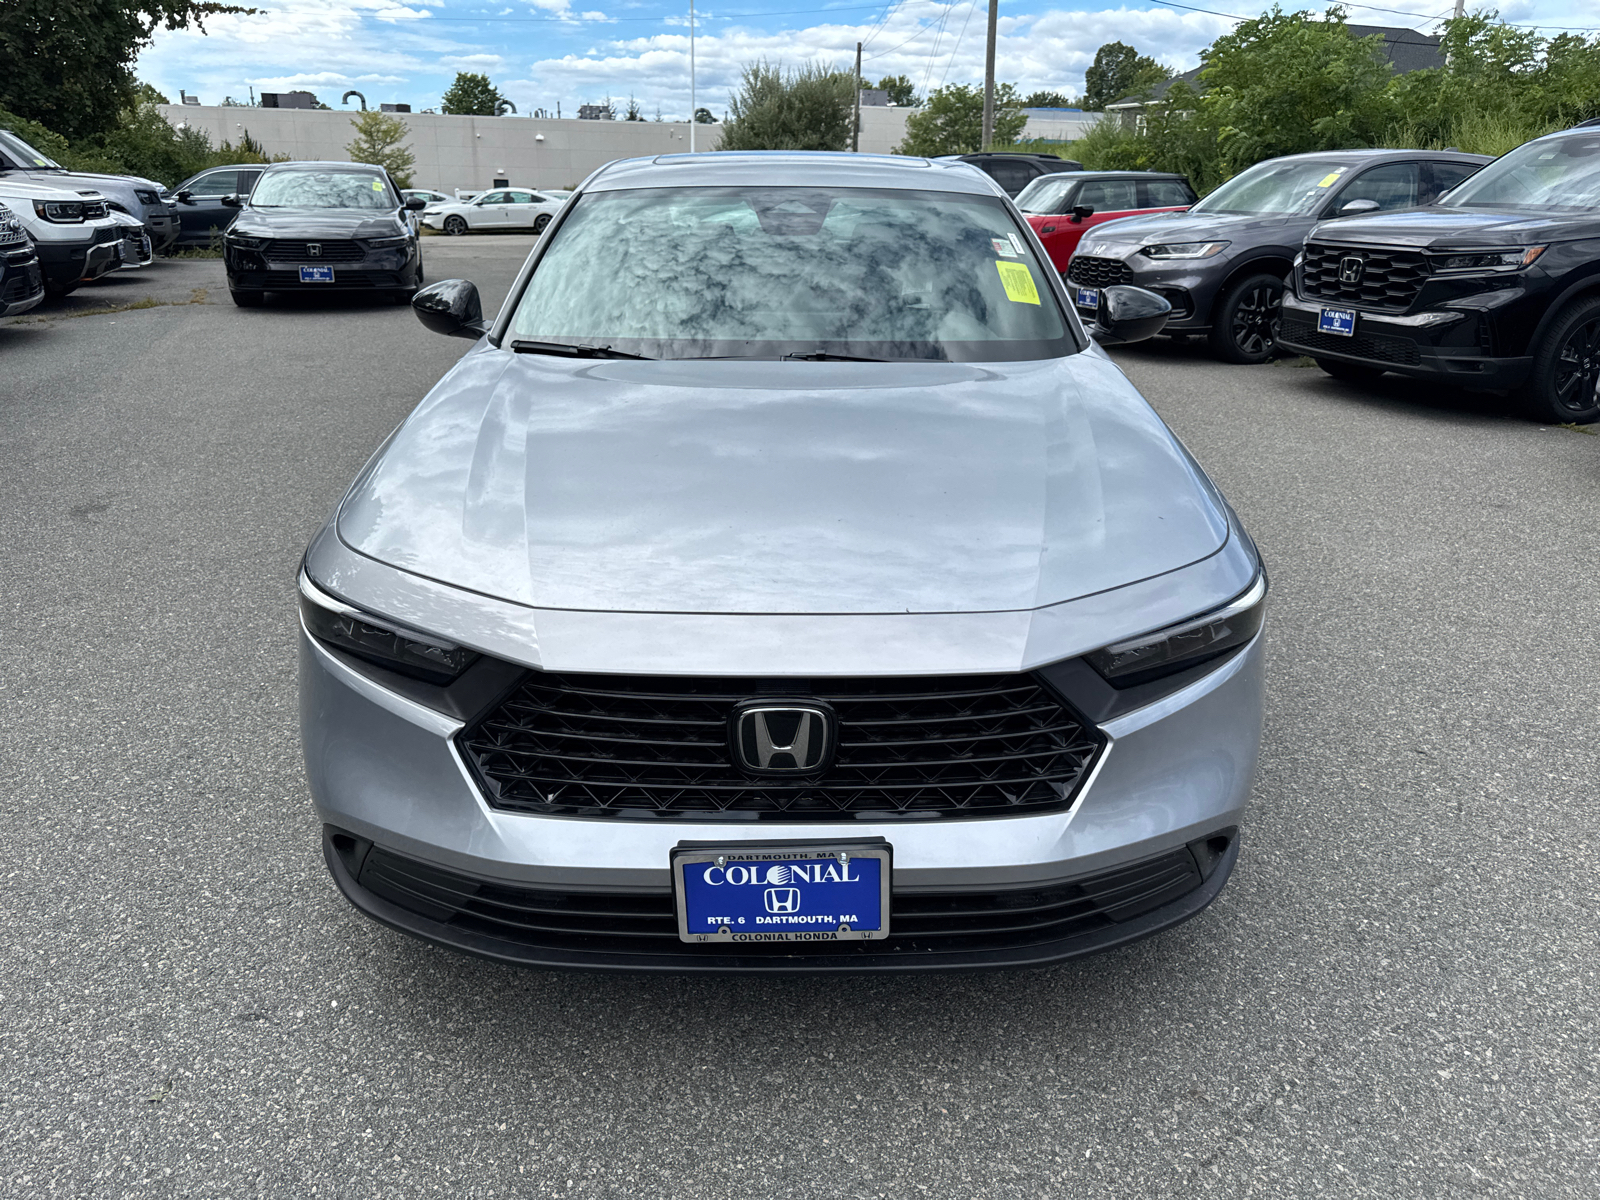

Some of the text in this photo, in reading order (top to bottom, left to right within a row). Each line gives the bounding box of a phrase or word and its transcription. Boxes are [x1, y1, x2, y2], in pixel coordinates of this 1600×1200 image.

[727, 853, 812, 861] DARTMOUTH,
[703, 863, 860, 886] COLONIAL
[707, 914, 859, 925] RTE. 6 DARTMOUTH, MA
[731, 932, 838, 941] COLONIAL HONDA
